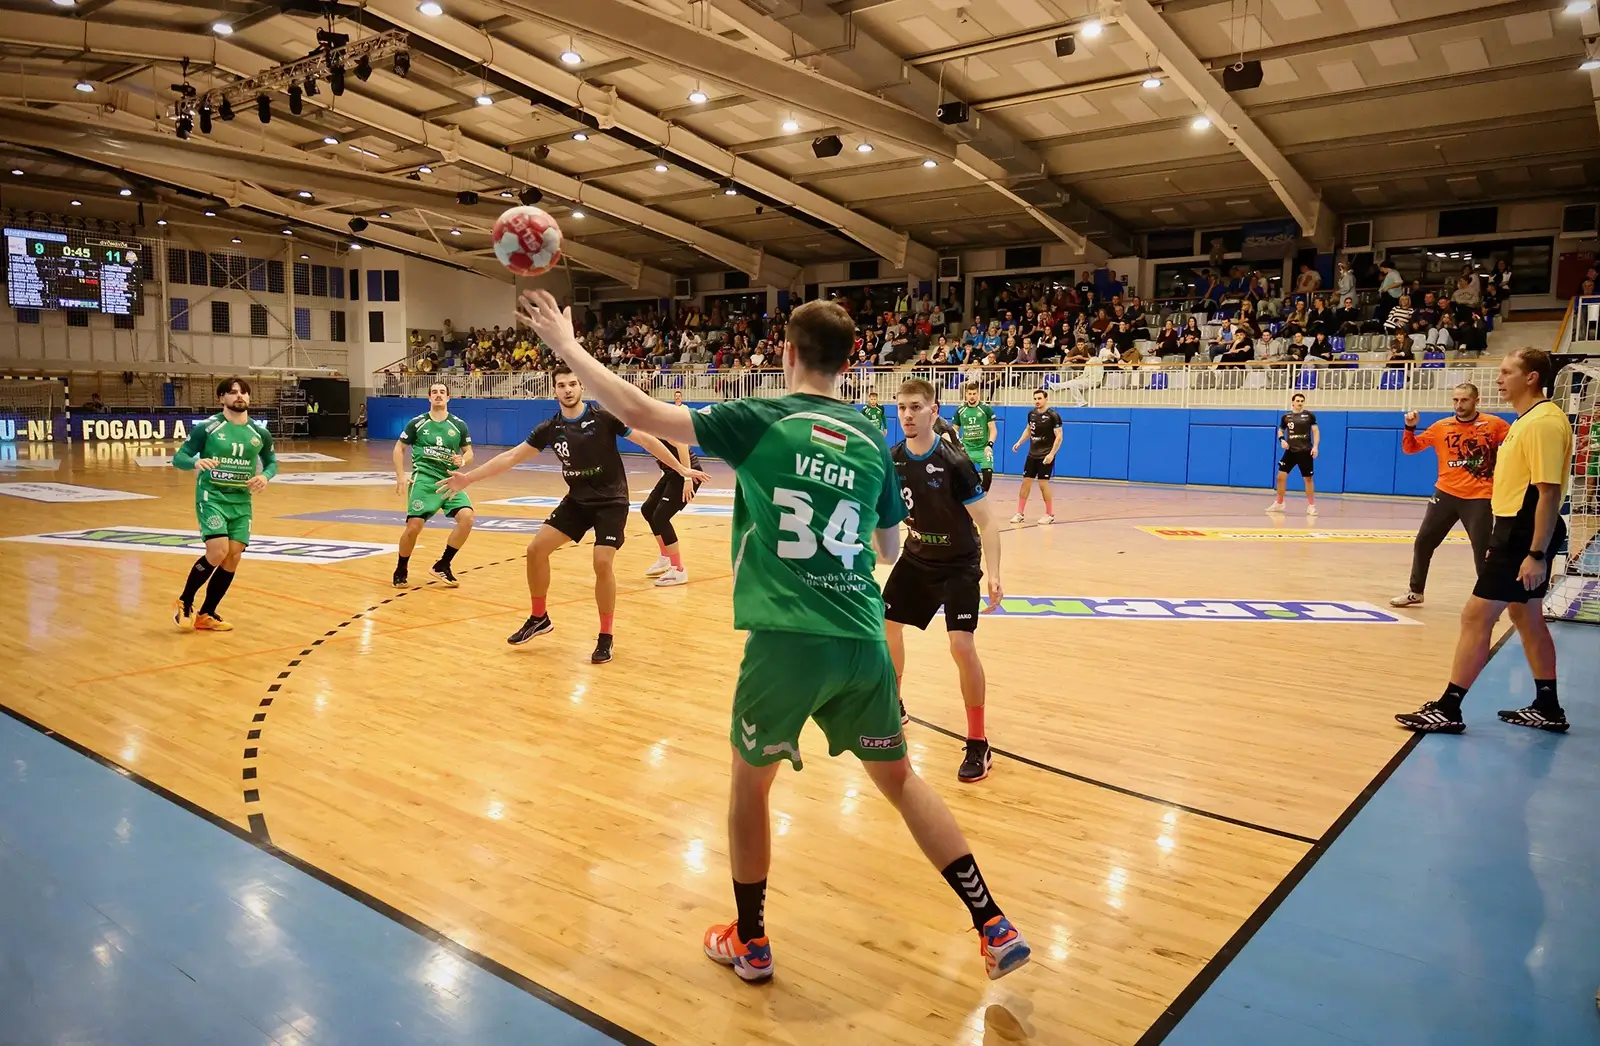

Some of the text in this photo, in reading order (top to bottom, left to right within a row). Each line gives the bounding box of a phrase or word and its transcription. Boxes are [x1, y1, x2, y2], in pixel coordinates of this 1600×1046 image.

[34, 242, 45, 255] 9
[62, 246, 91, 258] 0:45
[105, 249, 121, 263] 11
[74, 260, 81, 268] 2
[968, 416, 977, 425] 57
[82, 420, 166, 440] FOGADJ
[173, 420, 188, 439] A
[435, 435, 443, 446] 8
[1444, 433, 1463, 448] 12
[231, 442, 244, 457] 11
[554, 441, 570, 458] 38
[795, 452, 856, 490] VÉGH
[772, 486, 864, 570] 34
